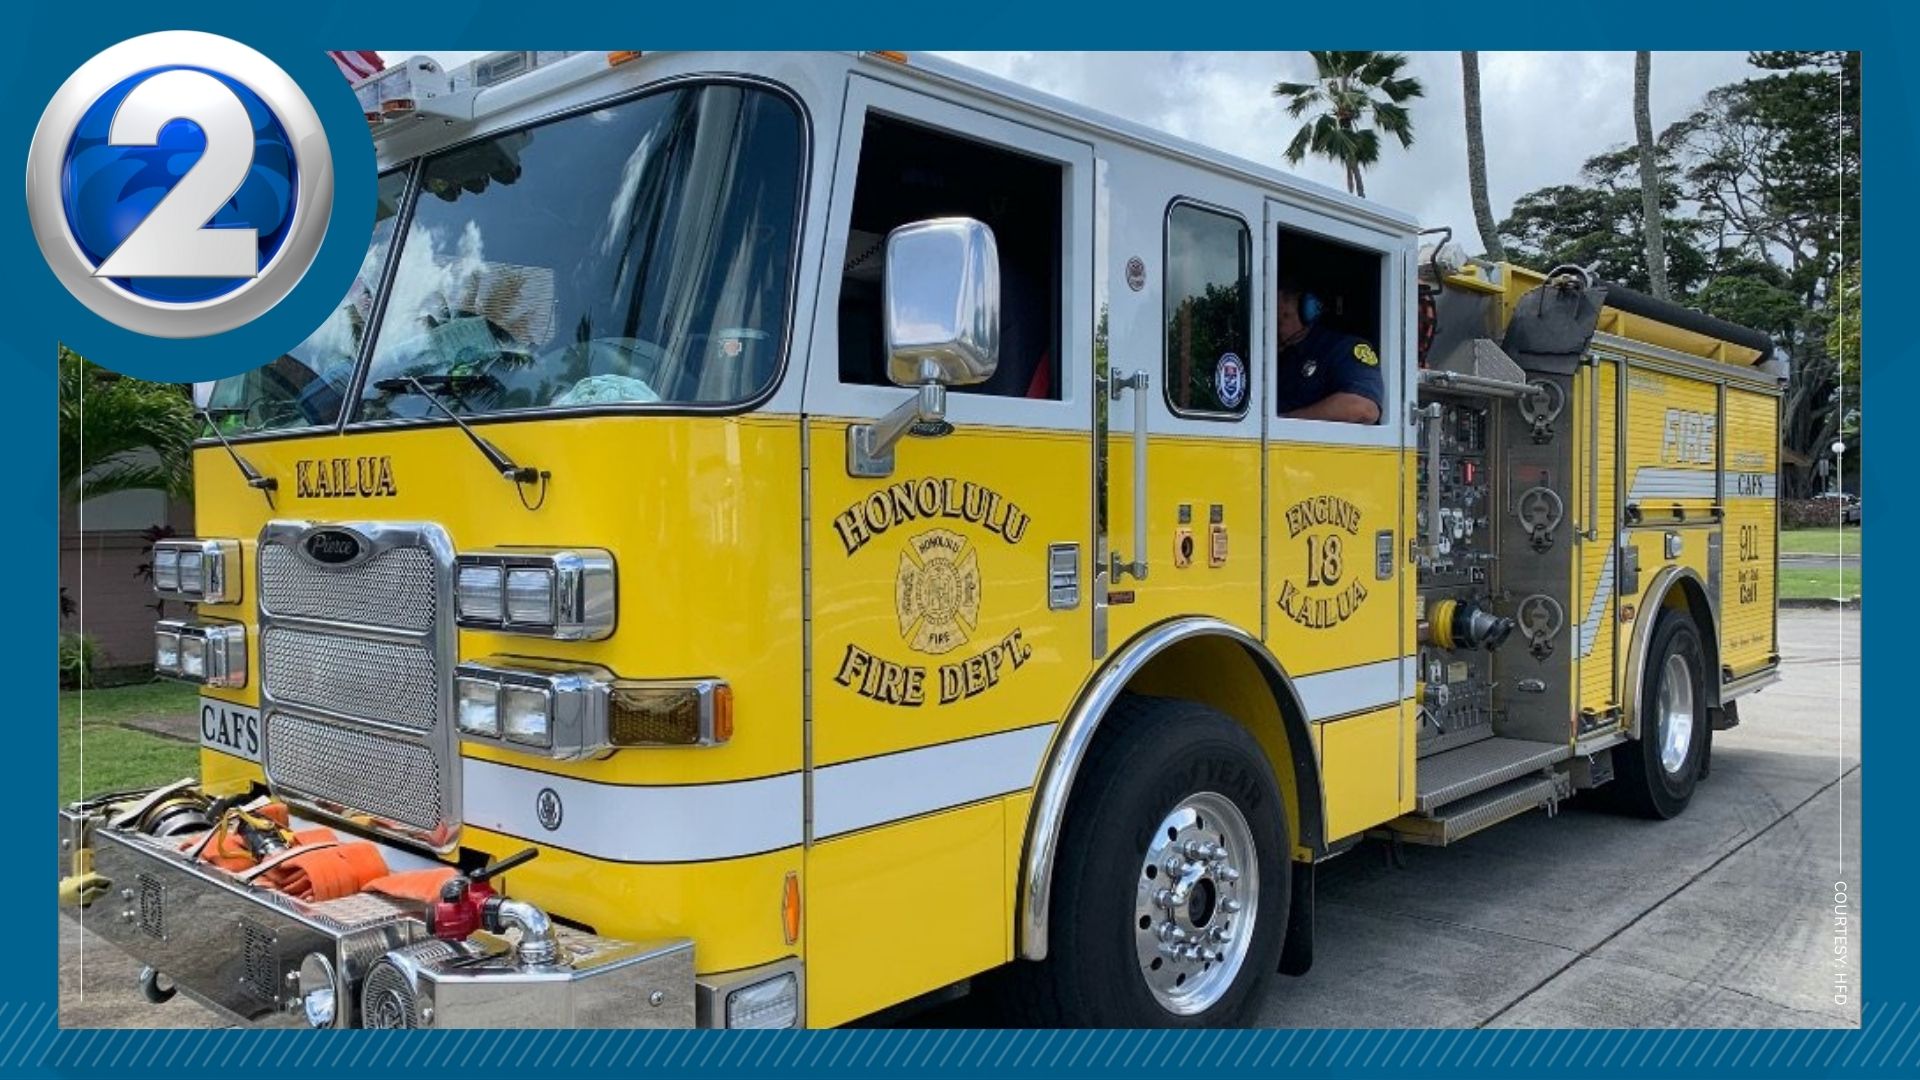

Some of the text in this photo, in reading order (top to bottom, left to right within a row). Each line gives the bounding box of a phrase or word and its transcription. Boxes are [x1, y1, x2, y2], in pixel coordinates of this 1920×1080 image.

[1662, 407, 1717, 464] FIRE
[296, 456, 397, 498] KAILUA
[1737, 473, 1764, 496] CAFS
[833, 476, 1030, 557] HONOLULU
[1285, 495, 1361, 538] ENGINE
[311, 534, 353, 554] Pierce
[918, 536, 959, 555] HONOLULU
[1307, 533, 1343, 587] 18
[1740, 524, 1759, 561] 911
[1276, 577, 1368, 629] KAILUA
[928, 632, 950, 644] FIRE
[834, 627, 1032, 706] FIRE DEPT.
[202, 704, 259, 755] CAFS
